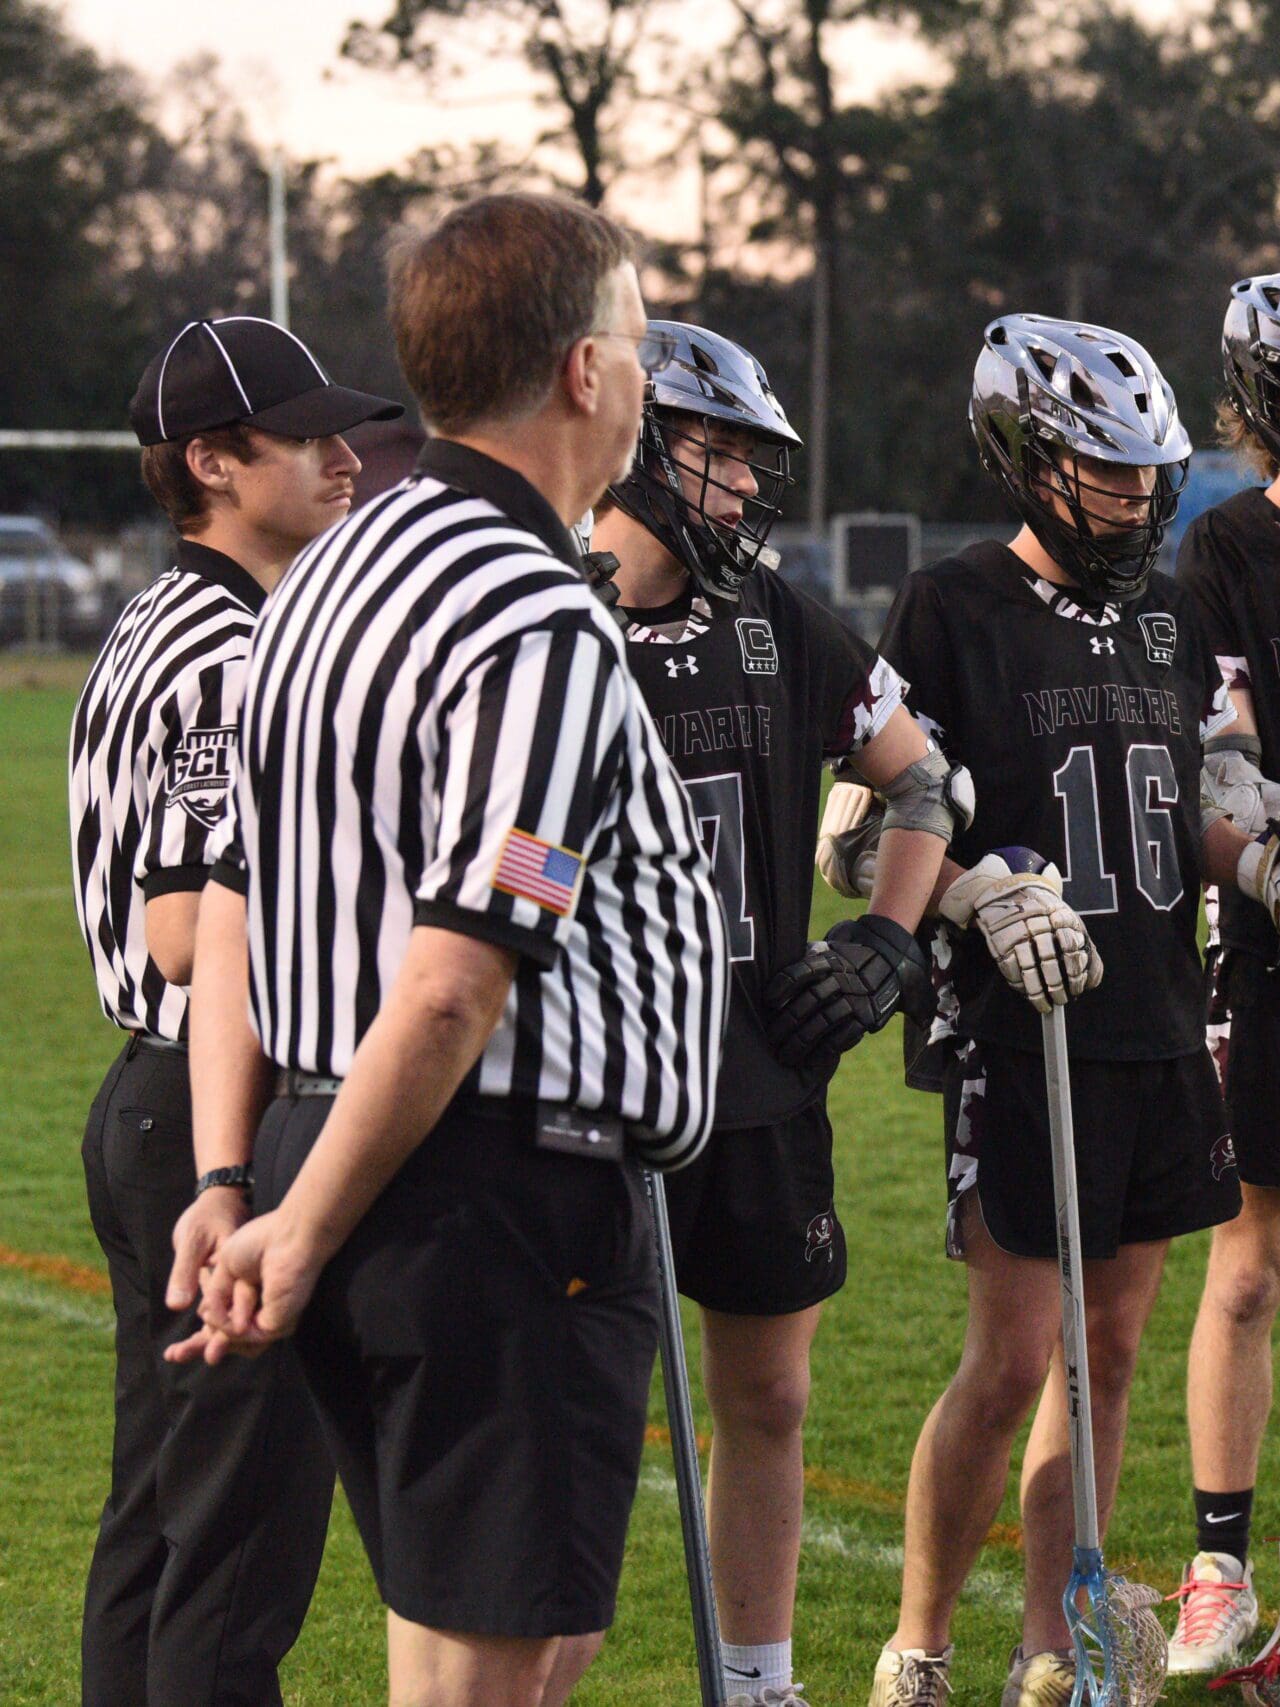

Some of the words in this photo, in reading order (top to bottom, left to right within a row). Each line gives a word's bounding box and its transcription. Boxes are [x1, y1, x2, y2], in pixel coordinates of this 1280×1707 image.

[737, 618, 777, 661] C
[1139, 613, 1177, 652] C
[653, 705, 770, 758] VARRE
[1023, 684, 1182, 736] NAVARRE
[1053, 743, 1184, 916] 16
